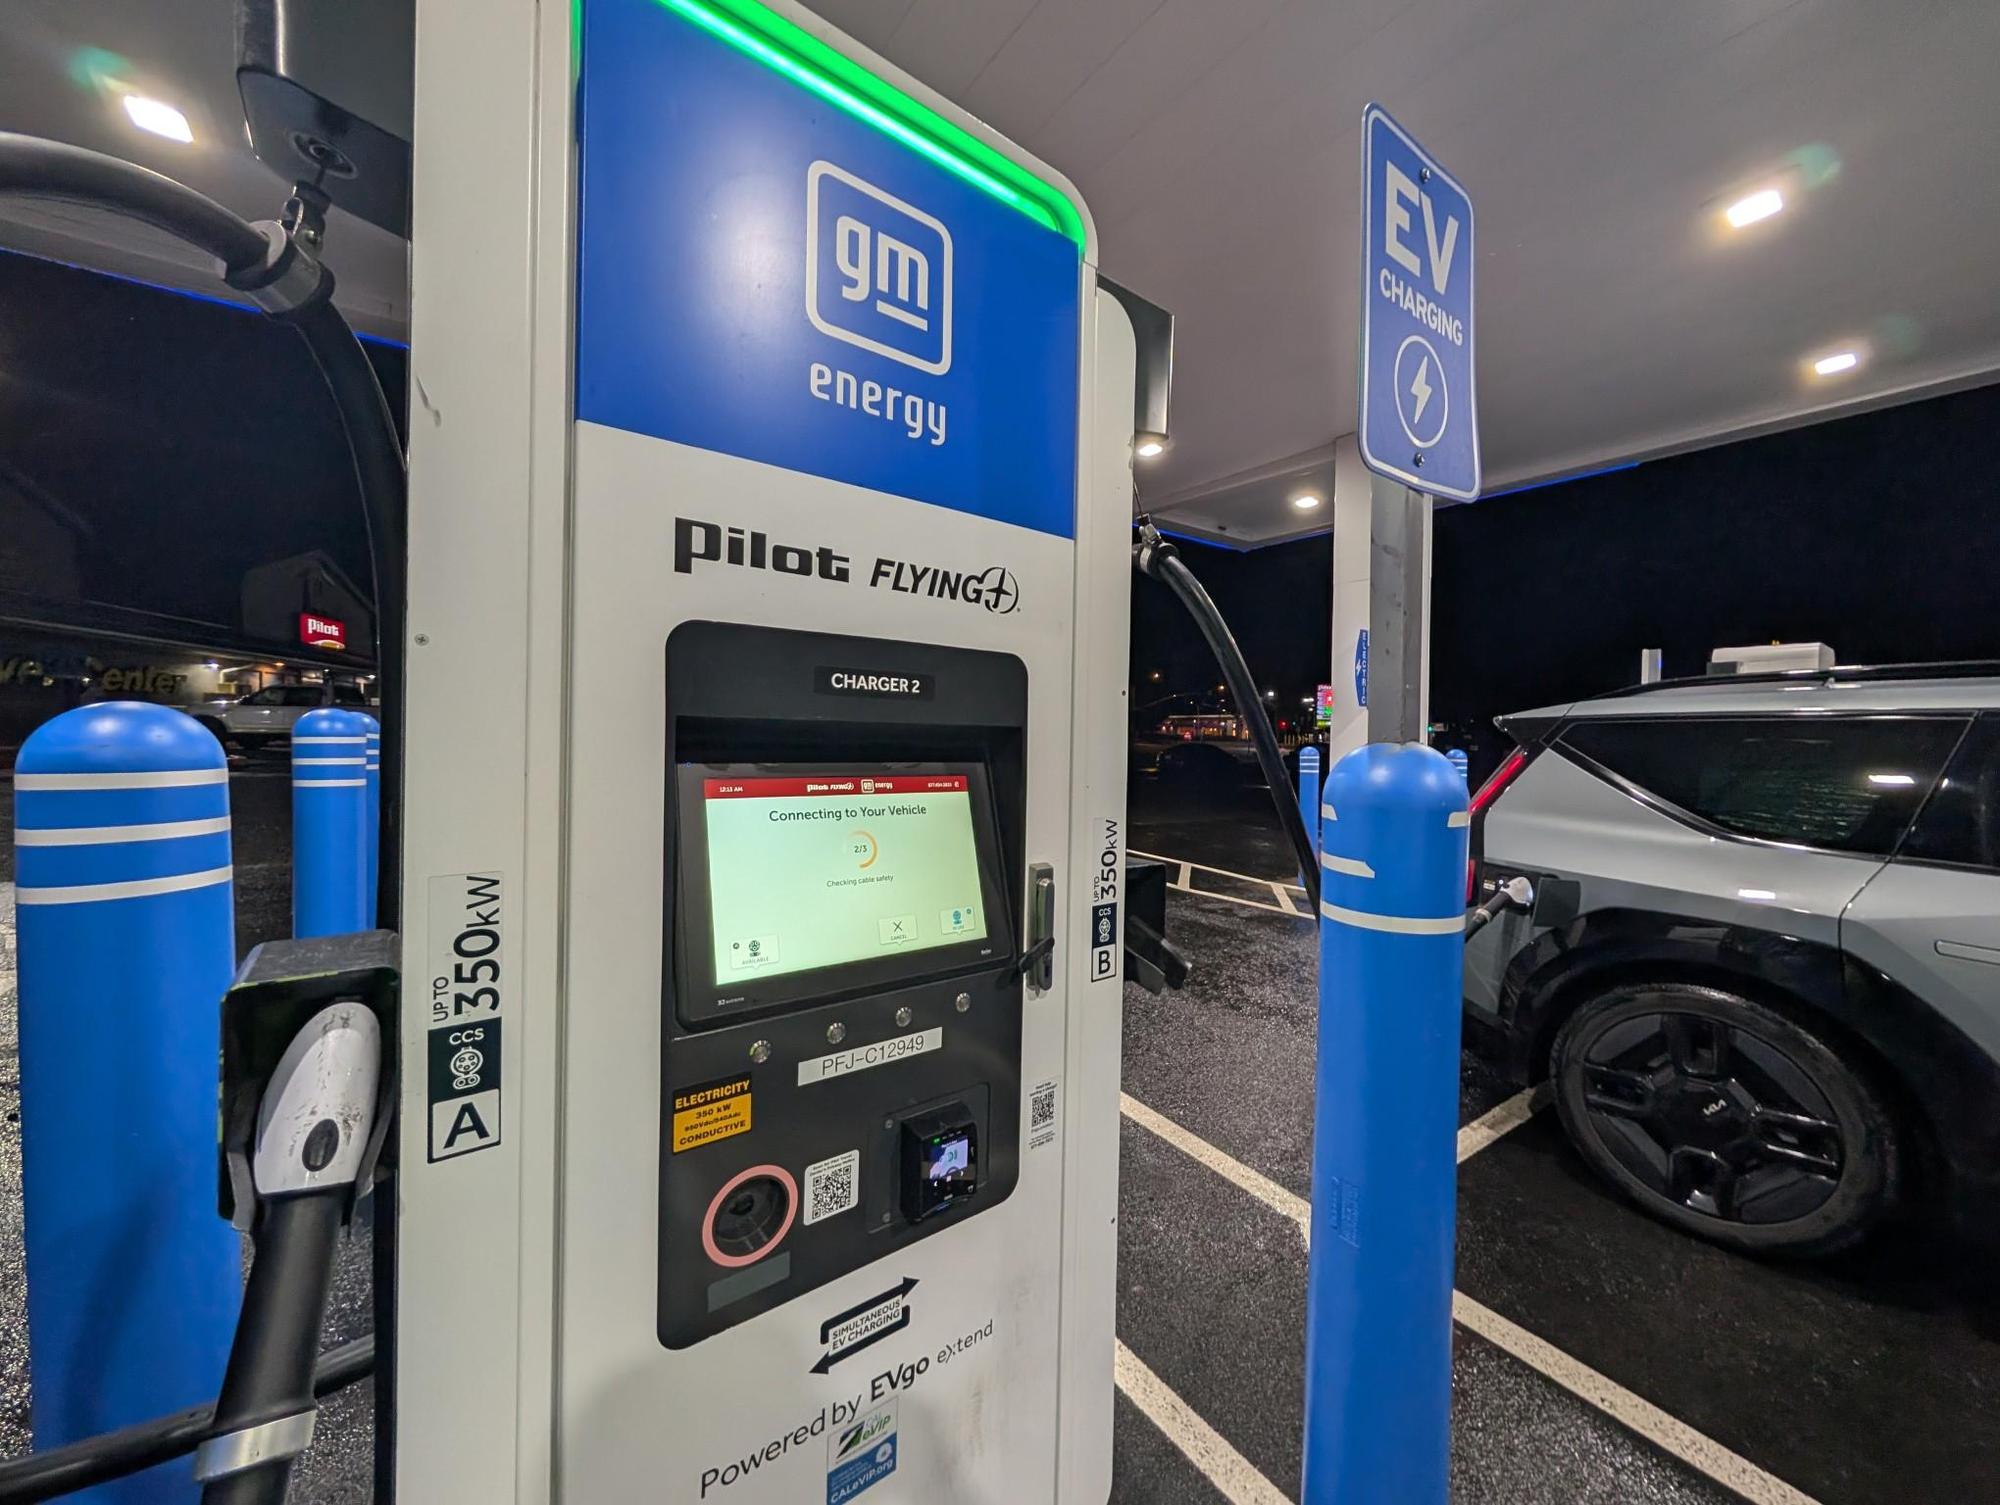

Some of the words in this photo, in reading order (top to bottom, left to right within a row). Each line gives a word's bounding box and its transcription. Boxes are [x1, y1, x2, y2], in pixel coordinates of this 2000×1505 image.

[1385, 160, 1459, 295] EV
[836, 216, 929, 313] gm
[1379, 268, 1463, 346] CHARGING
[810, 362, 946, 446] energy
[831, 673, 909, 693] CHARGER
[911, 680, 920, 693] 2
[769, 808, 842, 821] Connecting
[845, 808, 858, 818] to
[860, 806, 886, 817] Your
[888, 804, 927, 815] Vehicle
[854, 845, 867, 853] 2/3
[1100, 819, 1118, 900] 350kW
[826, 879, 857, 887] Checking
[858, 876, 875, 884] cable
[876, 874, 894, 882] safety
[1094, 876, 1100, 889] TO
[1094, 890, 1100, 902] UP
[1099, 907, 1111, 916] CCS
[453, 875, 500, 1016] 350kW
[1098, 950, 1111, 975] B
[433, 976, 449, 998] TO
[433, 999, 449, 1022] UP
[449, 1028, 485, 1045] CCS
[822, 1036, 925, 1076] PFJ-C12949
[675, 1079, 750, 1109] ELECTRICITY
[695, 1108, 714, 1119] 350
[716, 1103, 732, 1112] kW
[443, 1102, 490, 1149] A
[679, 1120, 746, 1145] CONDUCTIVE
[832, 1300, 901, 1339] SIMULTANEOUS
[832, 1337, 847, 1351] EV
[848, 1310, 901, 1342] CHARGING
[701, 1408, 826, 1499] Powered
[832, 1394, 862, 1427] by
[870, 1356, 929, 1402] EVgo
[863, 1415, 891, 1441] eVIP
[831, 1459, 893, 1503] CALeVIP.org
